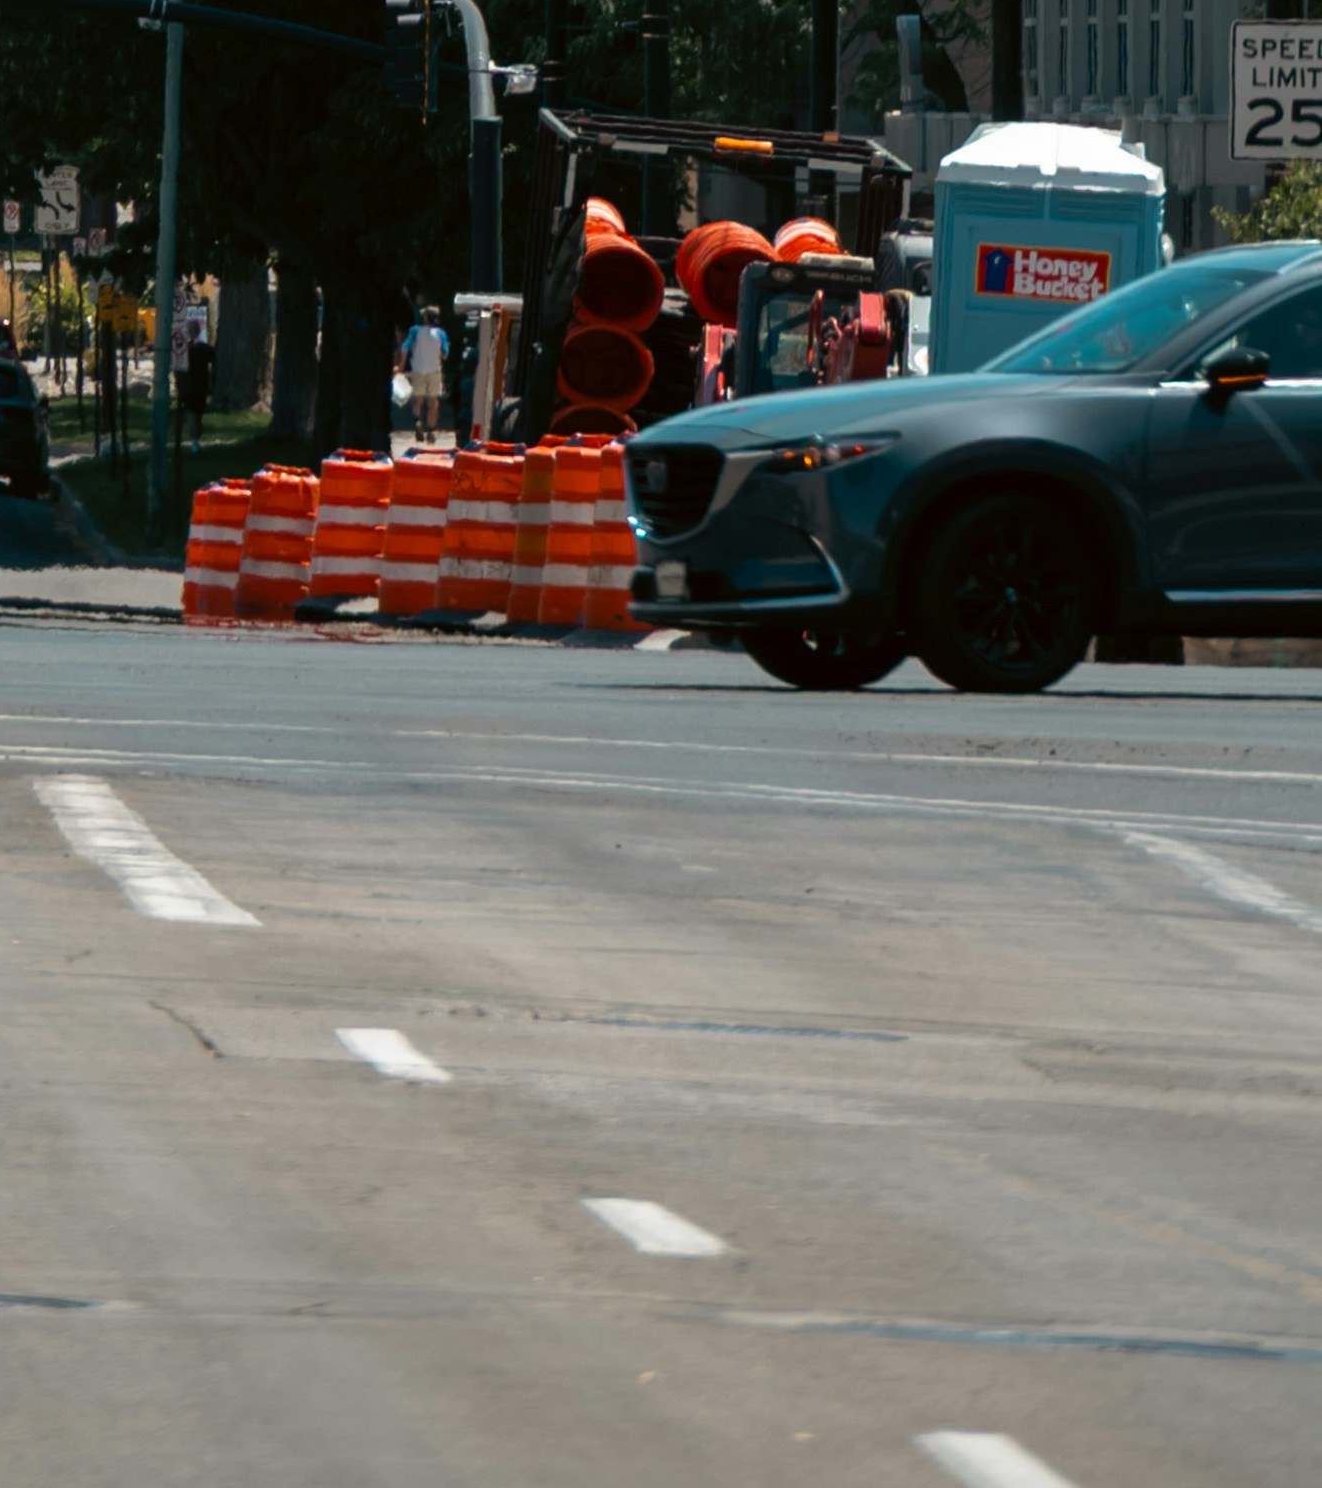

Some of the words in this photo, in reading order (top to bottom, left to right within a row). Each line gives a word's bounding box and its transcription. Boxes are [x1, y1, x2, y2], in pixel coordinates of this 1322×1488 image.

[1252, 66, 1322, 89] LIMIT
[1246, 97, 1322, 147] 25
[1014, 249, 1098, 282] Honey
[1013, 272, 1104, 300] Bucket
